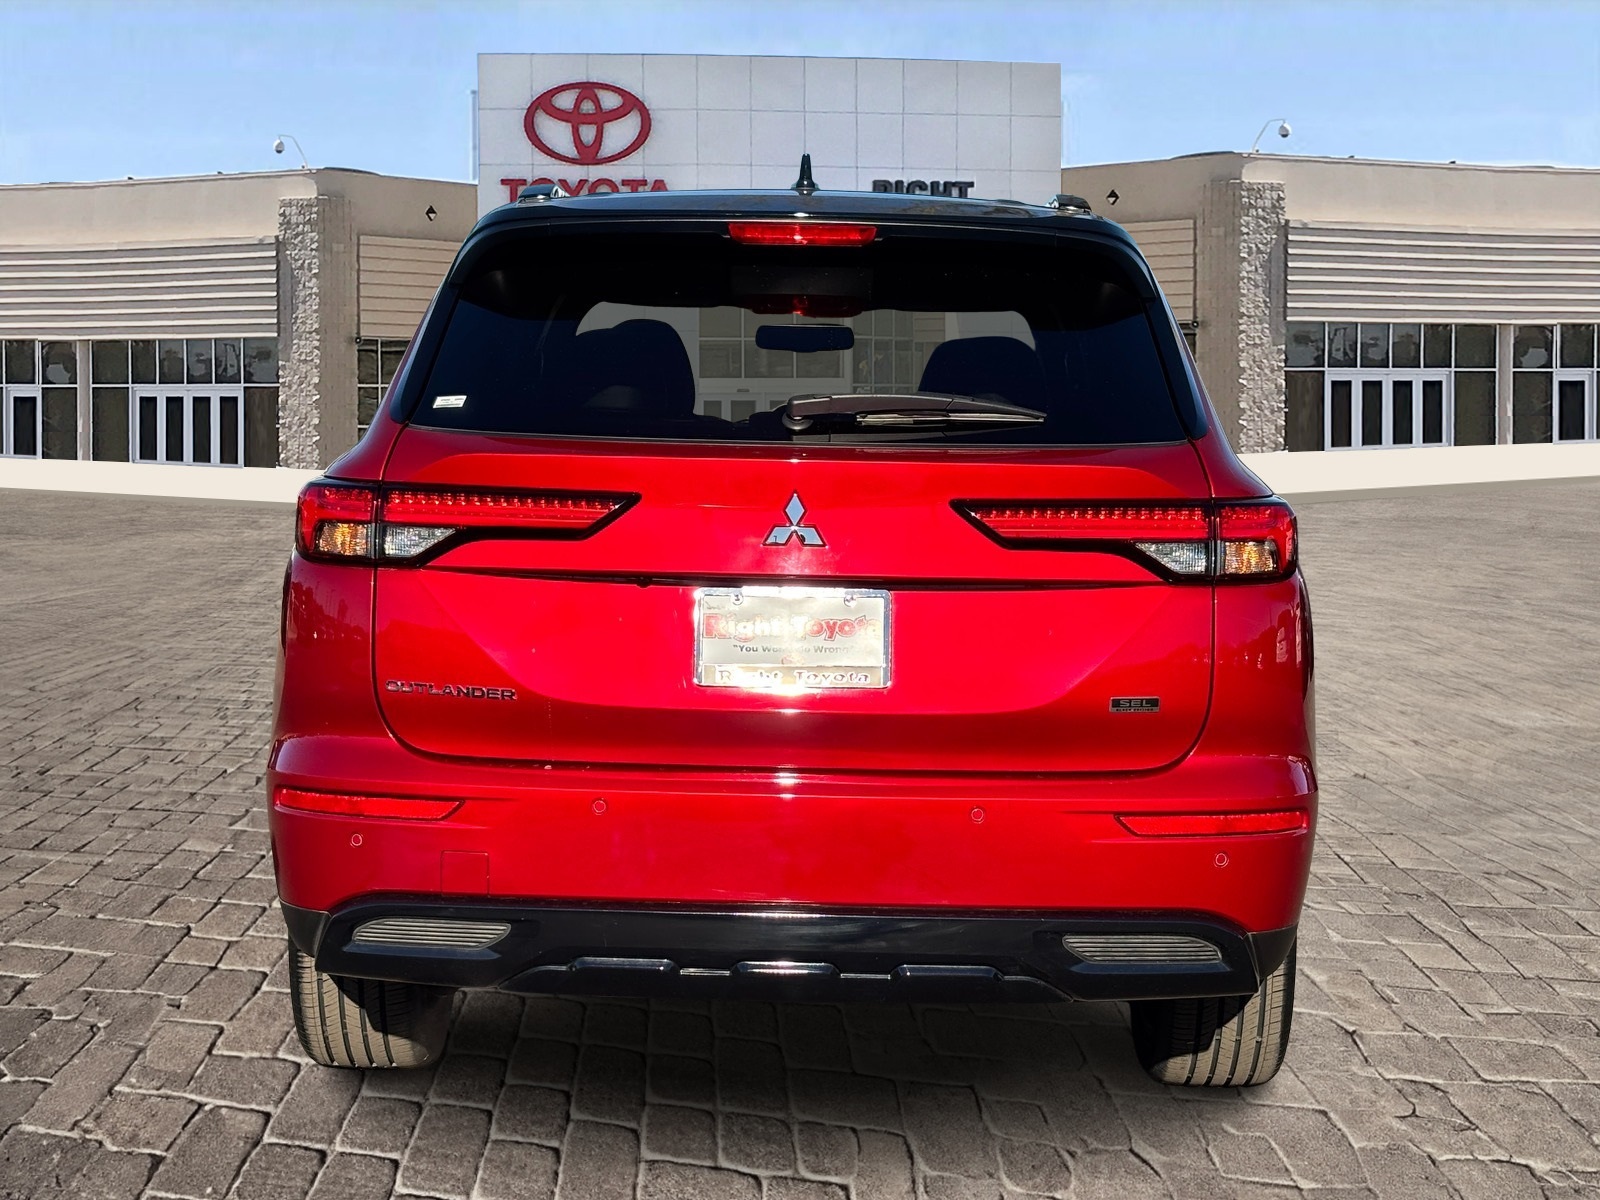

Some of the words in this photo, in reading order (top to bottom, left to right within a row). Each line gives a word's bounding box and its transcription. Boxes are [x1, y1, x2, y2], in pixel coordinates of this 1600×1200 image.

[732, 644, 759, 653] "You
[795, 671, 871, 684] Toyota
[385, 679, 518, 700] OUTLANDER
[1119, 699, 1151, 707] SEL
